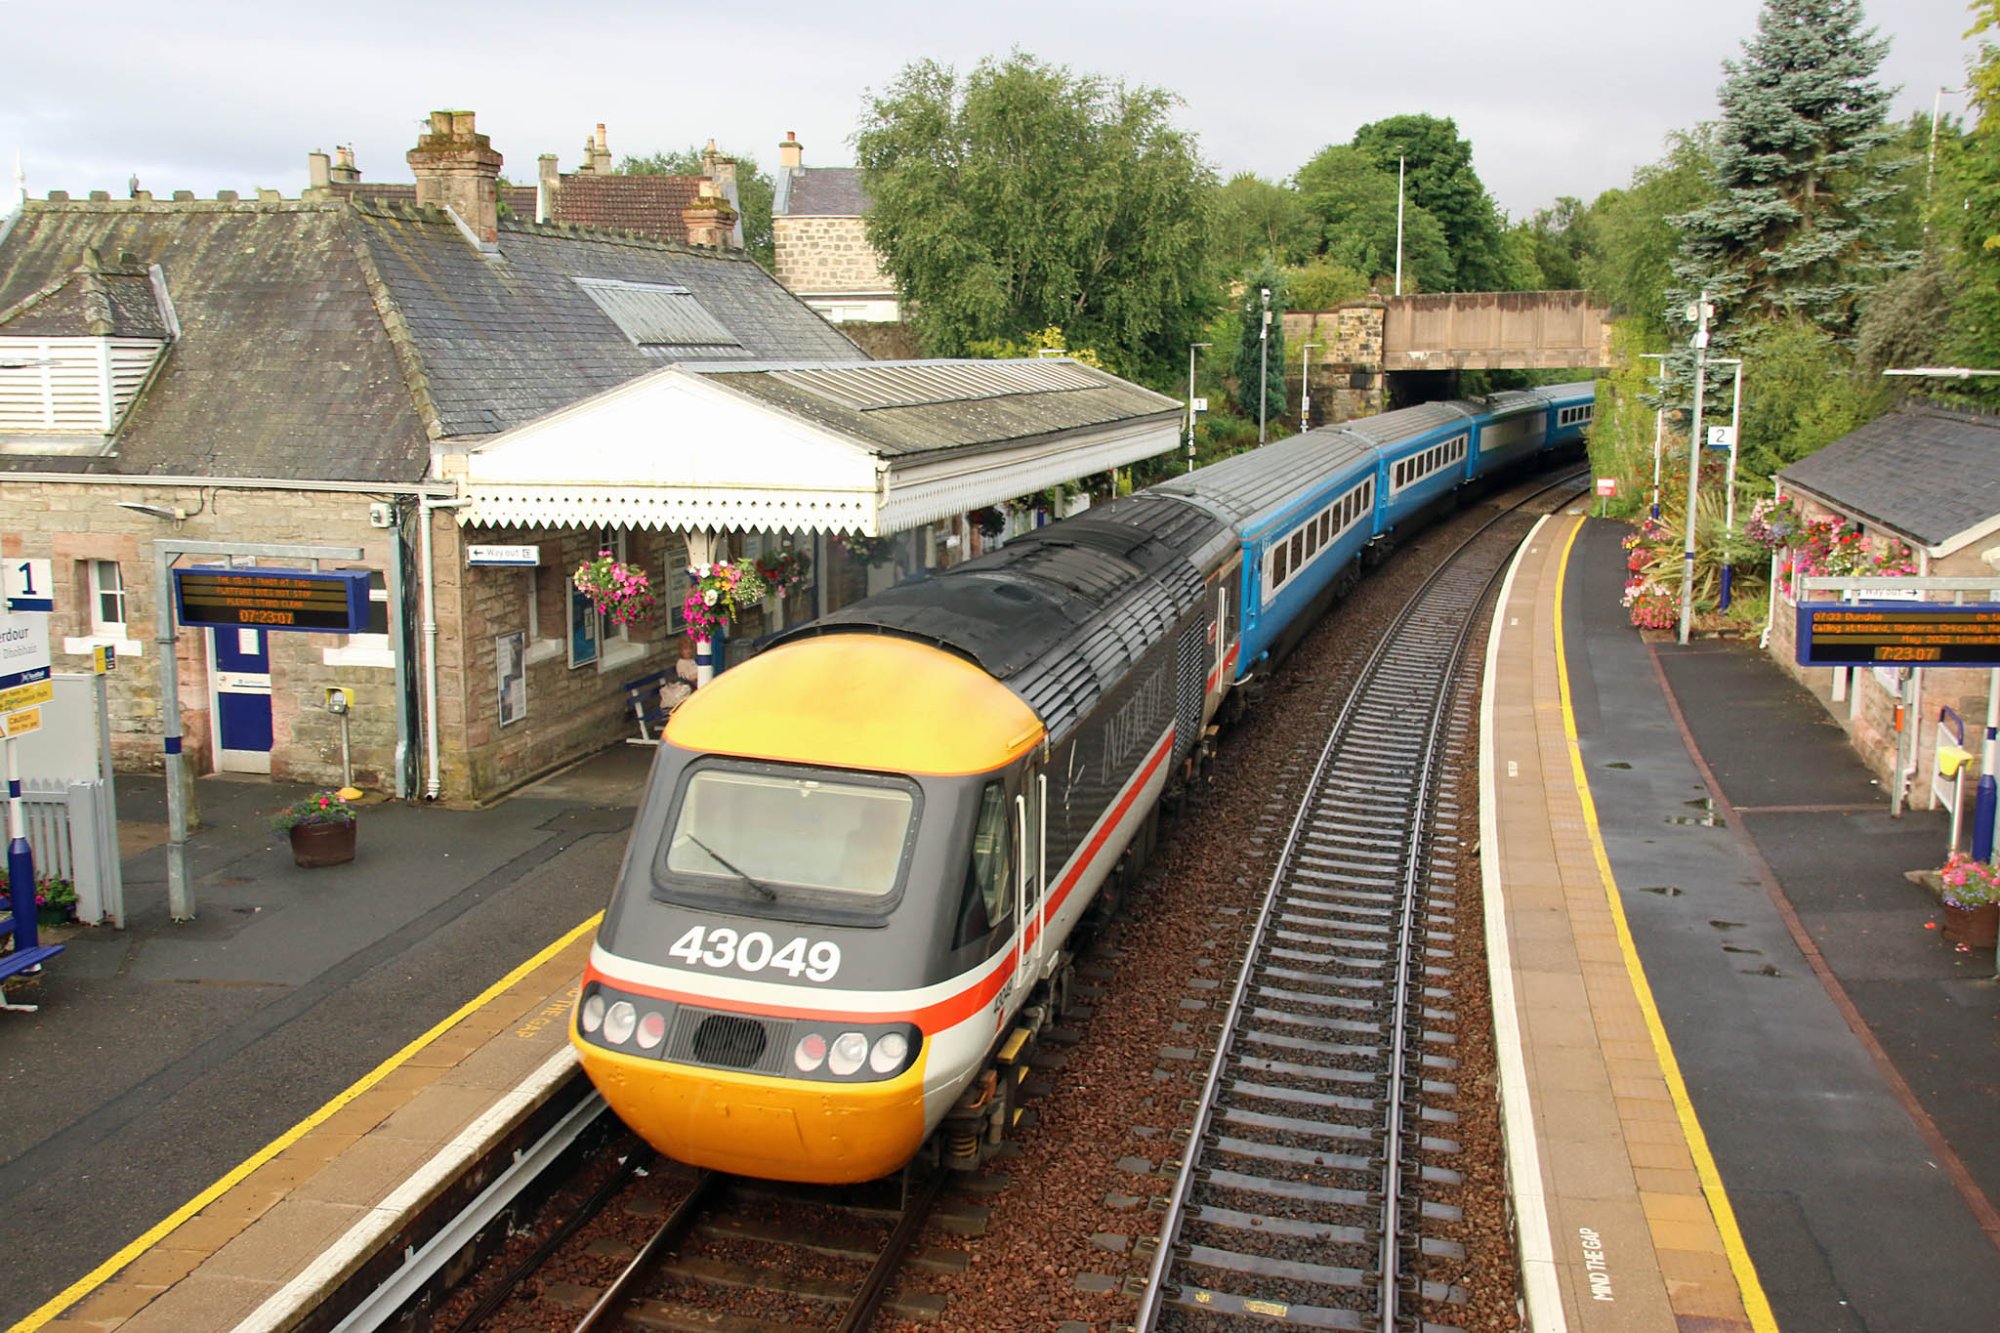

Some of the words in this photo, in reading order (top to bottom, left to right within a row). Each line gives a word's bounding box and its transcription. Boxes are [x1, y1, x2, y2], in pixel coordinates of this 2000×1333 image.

[1715, 429, 1726, 443] 2
[486, 549, 503, 558] Way
[507, 549, 519, 557] out
[18, 562, 37, 595] 1
[216, 576, 229, 584] THE
[293, 590, 312, 598] STOP
[239, 609, 293, 624] 07:23:07
[1813, 612, 1842, 622] 07:33
[1845, 612, 1883, 622] Dundee
[1812, 623, 1842, 634] Calling
[668, 925, 842, 983] 43049
[1578, 1227, 1602, 1250] GAP
[1583, 1249, 1607, 1271] THE
[1588, 1271, 1615, 1302] MIND
